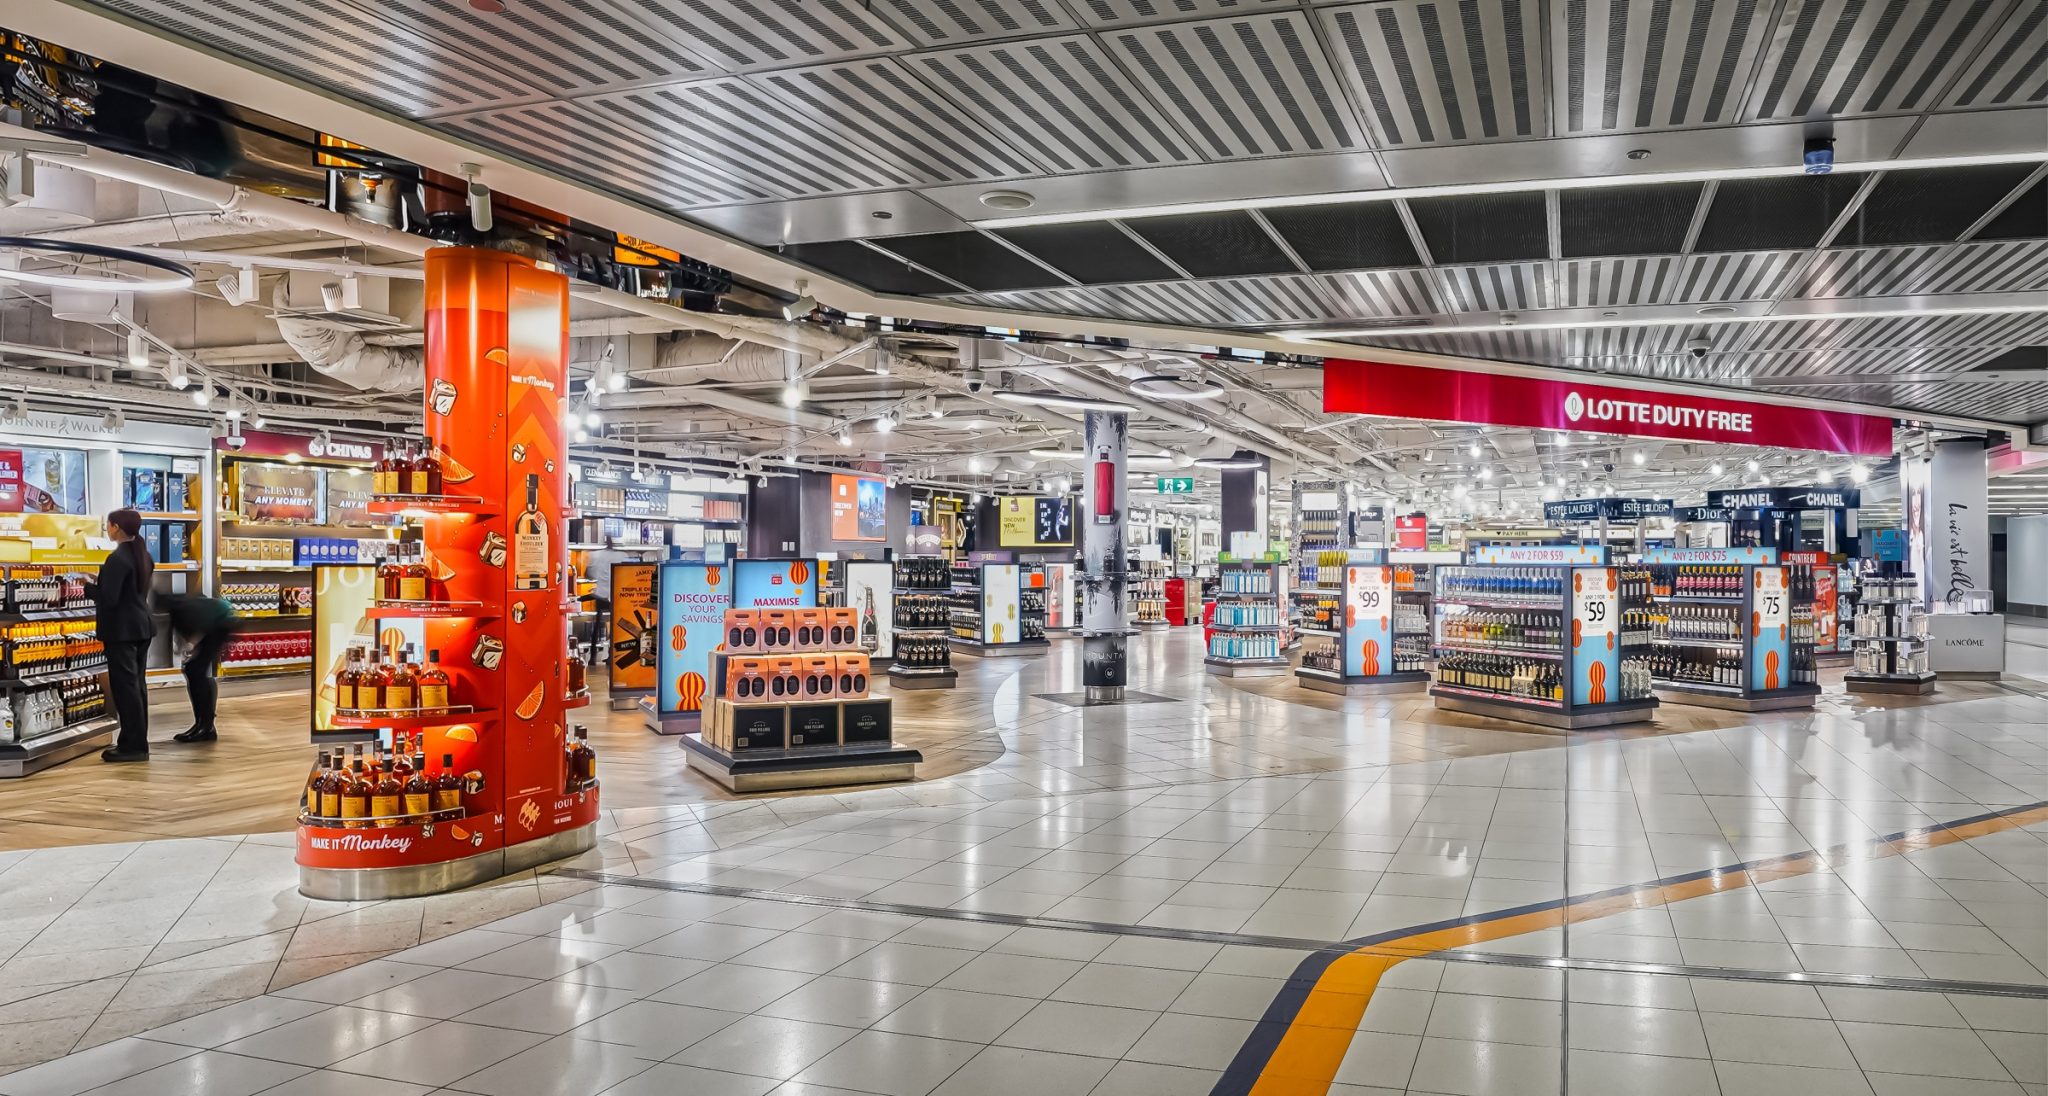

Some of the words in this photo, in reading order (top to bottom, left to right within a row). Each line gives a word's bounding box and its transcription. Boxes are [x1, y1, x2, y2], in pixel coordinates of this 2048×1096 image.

[528, 376, 554, 391] Monkey
[1588, 398, 1650, 423] LOTTE
[1654, 405, 1704, 428] DUTY
[1707, 410, 1752, 432] FREE
[326, 443, 372, 459] CHIVAS
[264, 486, 305, 497] ELEVATE
[255, 496, 274, 504] ANY
[275, 497, 313, 506] MOMENT
[339, 500, 356, 508] ANY
[1722, 493, 1773, 508] CHANEL
[1807, 493, 1844, 507] CHANEL
[1568, 503, 1594, 514] LAUDER
[1642, 503, 1666, 512] LAUDER
[1698, 508, 1723, 520] Dior
[1950, 538, 1968, 558] est
[1510, 551, 1525, 560] ANY
[1527, 551, 1532, 560] 2
[1533, 551, 1548, 560] FOR
[1550, 550, 1564, 561] $59
[1672, 552, 1687, 561] ANY
[1688, 552, 1693, 561] 2
[1694, 551, 1711, 561] FOR
[1712, 550, 1727, 562] $75
[1789, 553, 1816, 564] COINTREAU
[674, 593, 730, 604] DISCOVER
[753, 597, 800, 607] MAXIMISE
[1359, 591, 1380, 607] $99
[689, 605, 716, 613] YOUR
[1762, 596, 1780, 615] $75
[1584, 601, 1606, 622] $59
[681, 614, 724, 624] SAVINGS
[620, 641, 637, 649] NEW
[1945, 638, 1985, 647] LANCÔME
[311, 837, 330, 850] MAKE
[332, 838, 340, 850] IT
[340, 833, 412, 853] Monkey
